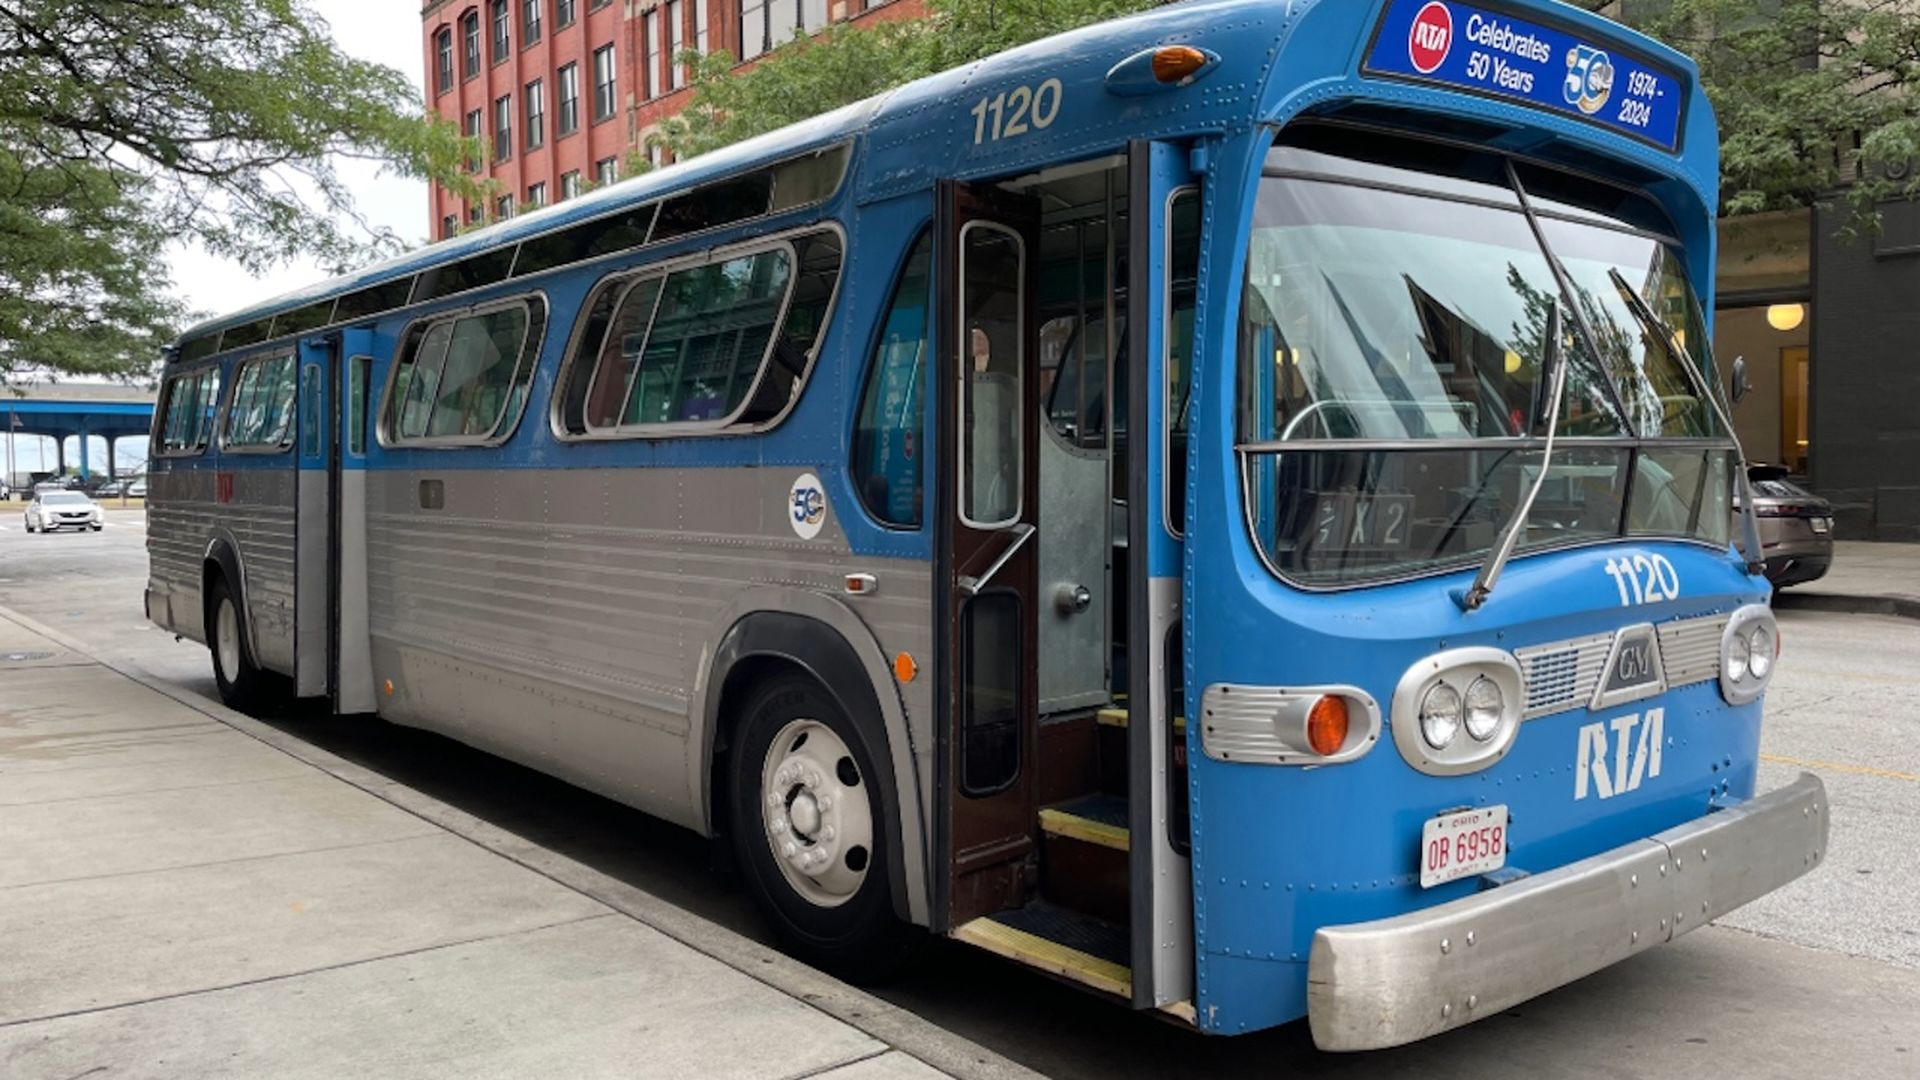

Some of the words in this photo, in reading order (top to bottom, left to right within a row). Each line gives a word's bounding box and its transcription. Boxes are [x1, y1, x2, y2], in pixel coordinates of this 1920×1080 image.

[1415, 22, 1448, 51] RTA
[1465, 14, 1551, 65] Celebrates
[1466, 51, 1490, 82] 50
[1490, 57, 1535, 94] Years
[970, 77, 1063, 145] 1120
[1618, 99, 1652, 128] 2024
[1604, 553, 1679, 607] 1120
[1619, 646, 1649, 681] GM
[1574, 707, 1665, 801] RTA
[1452, 815, 1480, 828] OHIO
[1456, 826, 1503, 864] 6958
